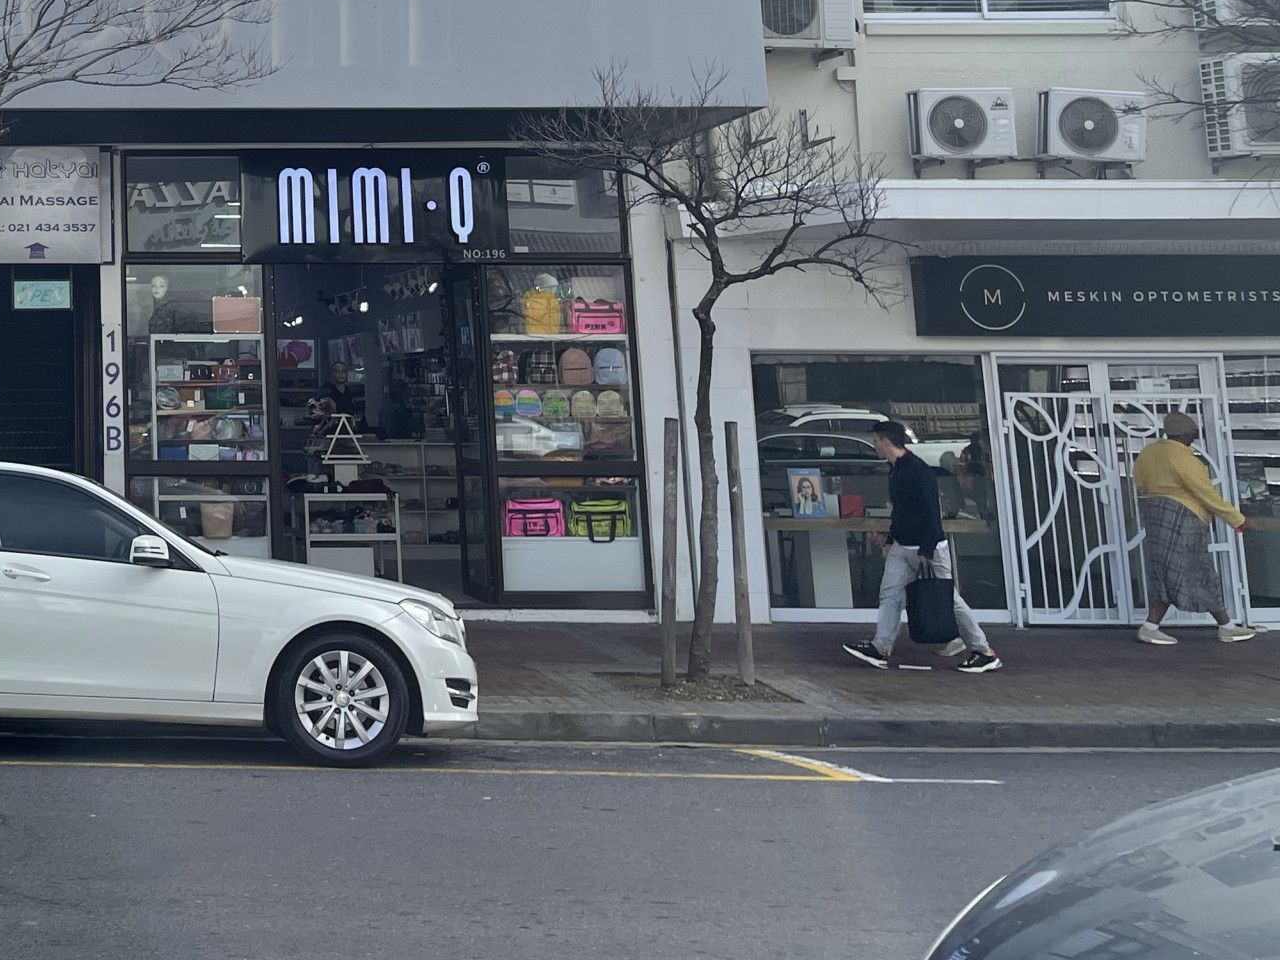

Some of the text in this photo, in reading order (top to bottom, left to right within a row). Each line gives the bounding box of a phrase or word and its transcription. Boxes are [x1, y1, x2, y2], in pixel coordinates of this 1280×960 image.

[8, 223, 30, 233] 021
[35, 223, 60, 232] 434
[63, 223, 96, 232] 3537
[463, 248, 506, 259] NO:196
[984, 289, 1002, 306] M
[1048, 290, 1280, 303] MESKIN OPTOMETRISTS
[584, 322, 608, 330] PINK
[104, 330, 122, 451] 196B
